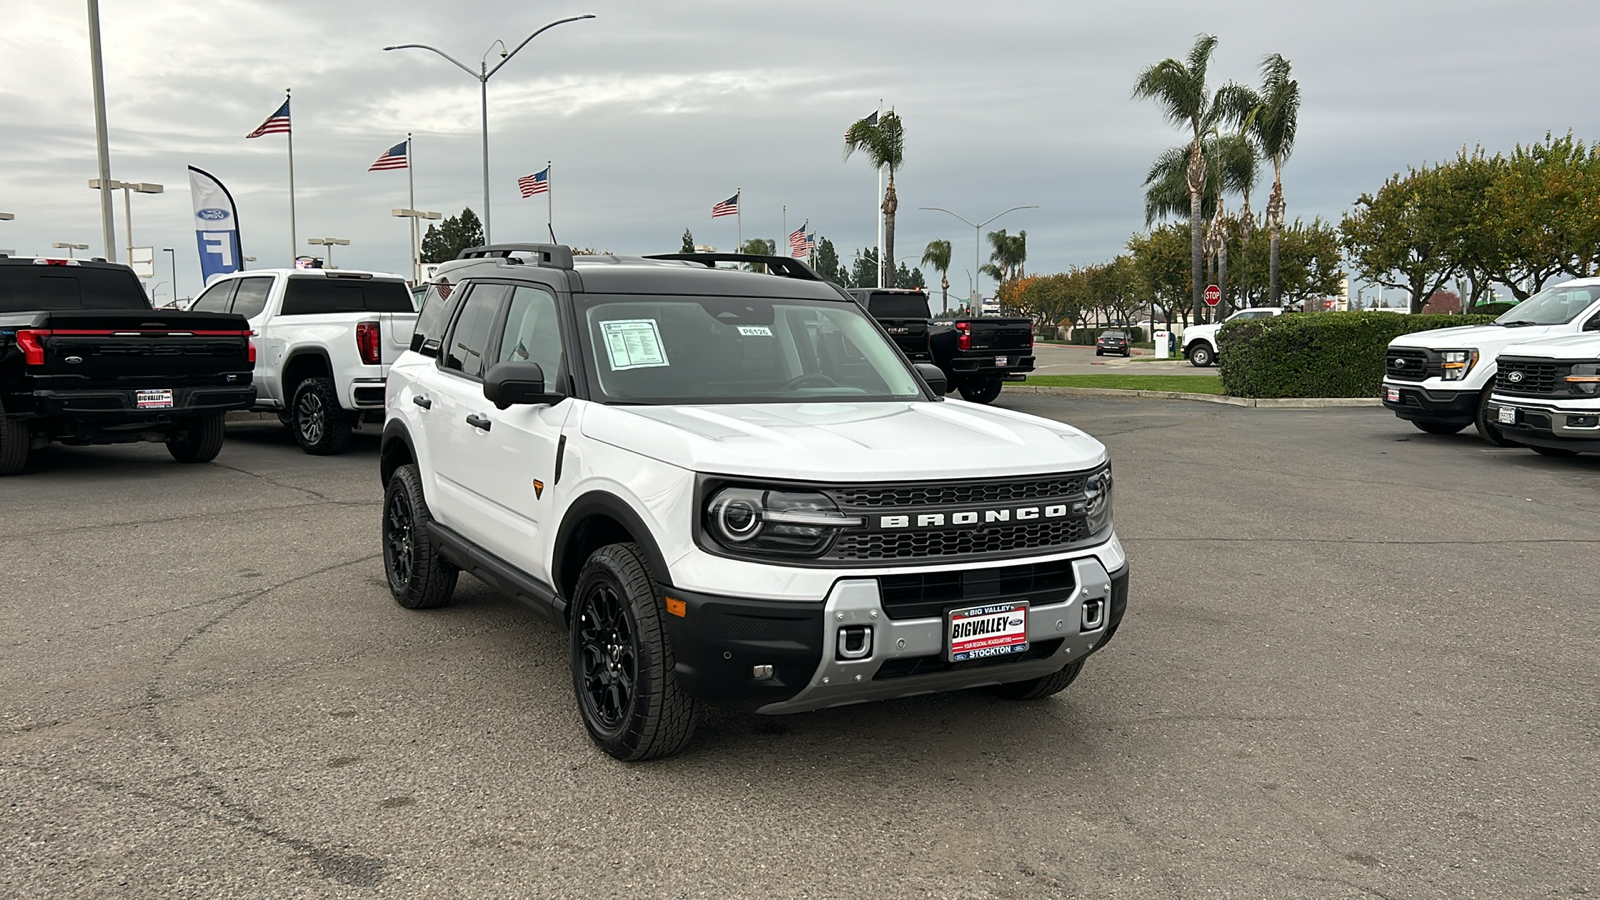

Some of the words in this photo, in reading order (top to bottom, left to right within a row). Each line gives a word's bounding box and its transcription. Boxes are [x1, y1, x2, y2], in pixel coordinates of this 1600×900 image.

[1205, 291, 1220, 300] STOP
[880, 504, 1067, 528] BRONCO
[969, 608, 983, 616] BIG
[984, 604, 1011, 613] VALLEY
[969, 645, 1011, 658] STOCKTON
